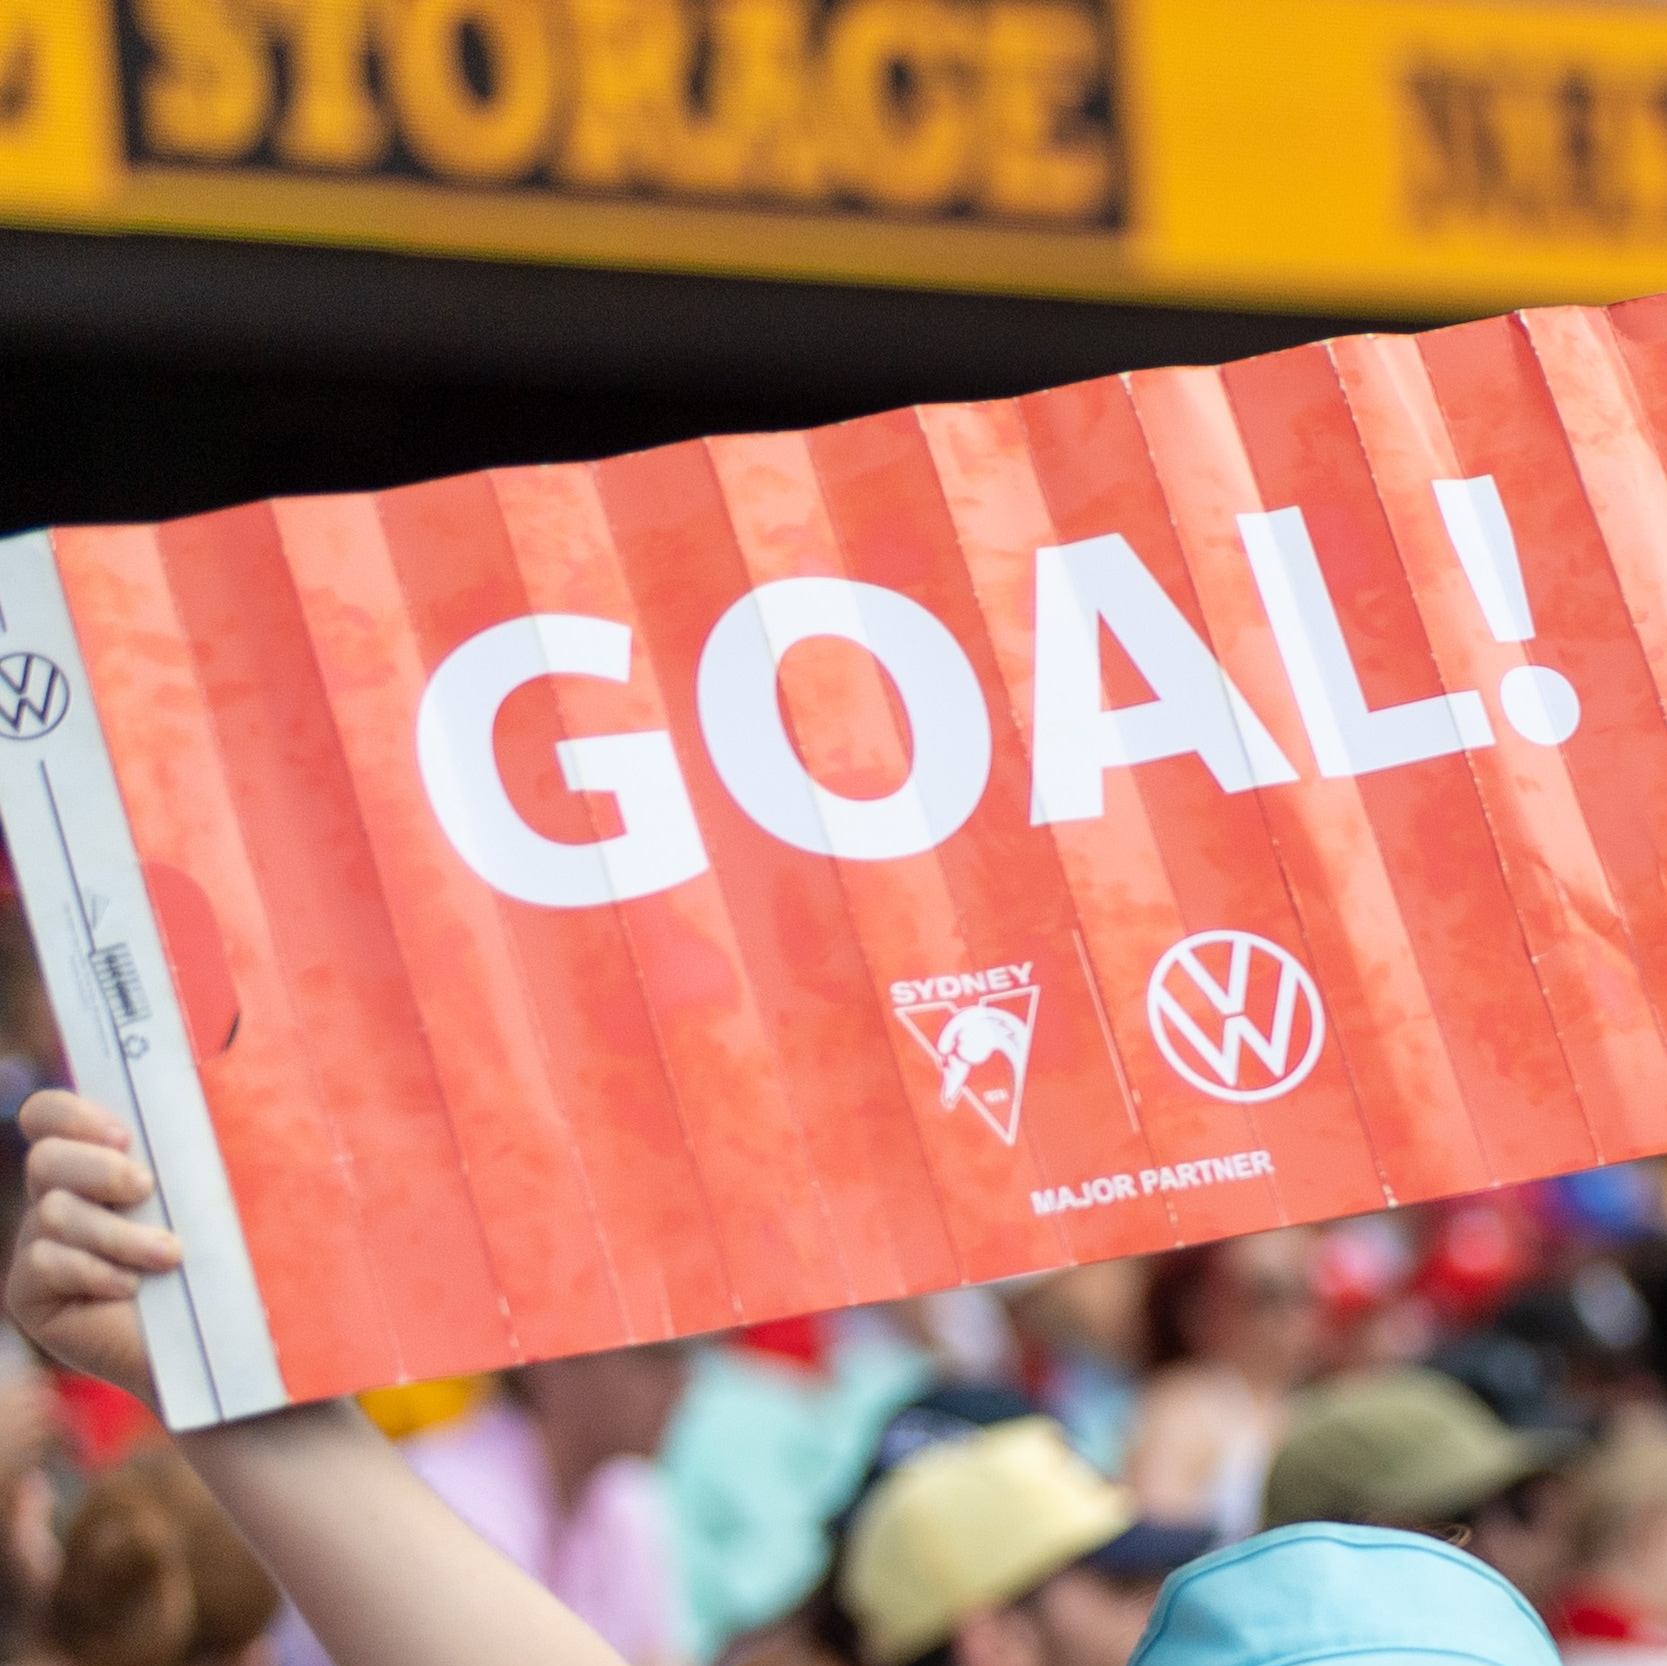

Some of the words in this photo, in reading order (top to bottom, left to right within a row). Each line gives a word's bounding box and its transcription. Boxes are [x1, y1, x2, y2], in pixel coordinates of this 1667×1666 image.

[140, 0, 1112, 220] STORAGE
[416, 475, 1581, 907] GOAL!
[889, 961, 1034, 1006] SYDNEY
[1030, 1172, 1137, 1216] MAJOR
[1140, 1149, 1275, 1196] PARTNER
